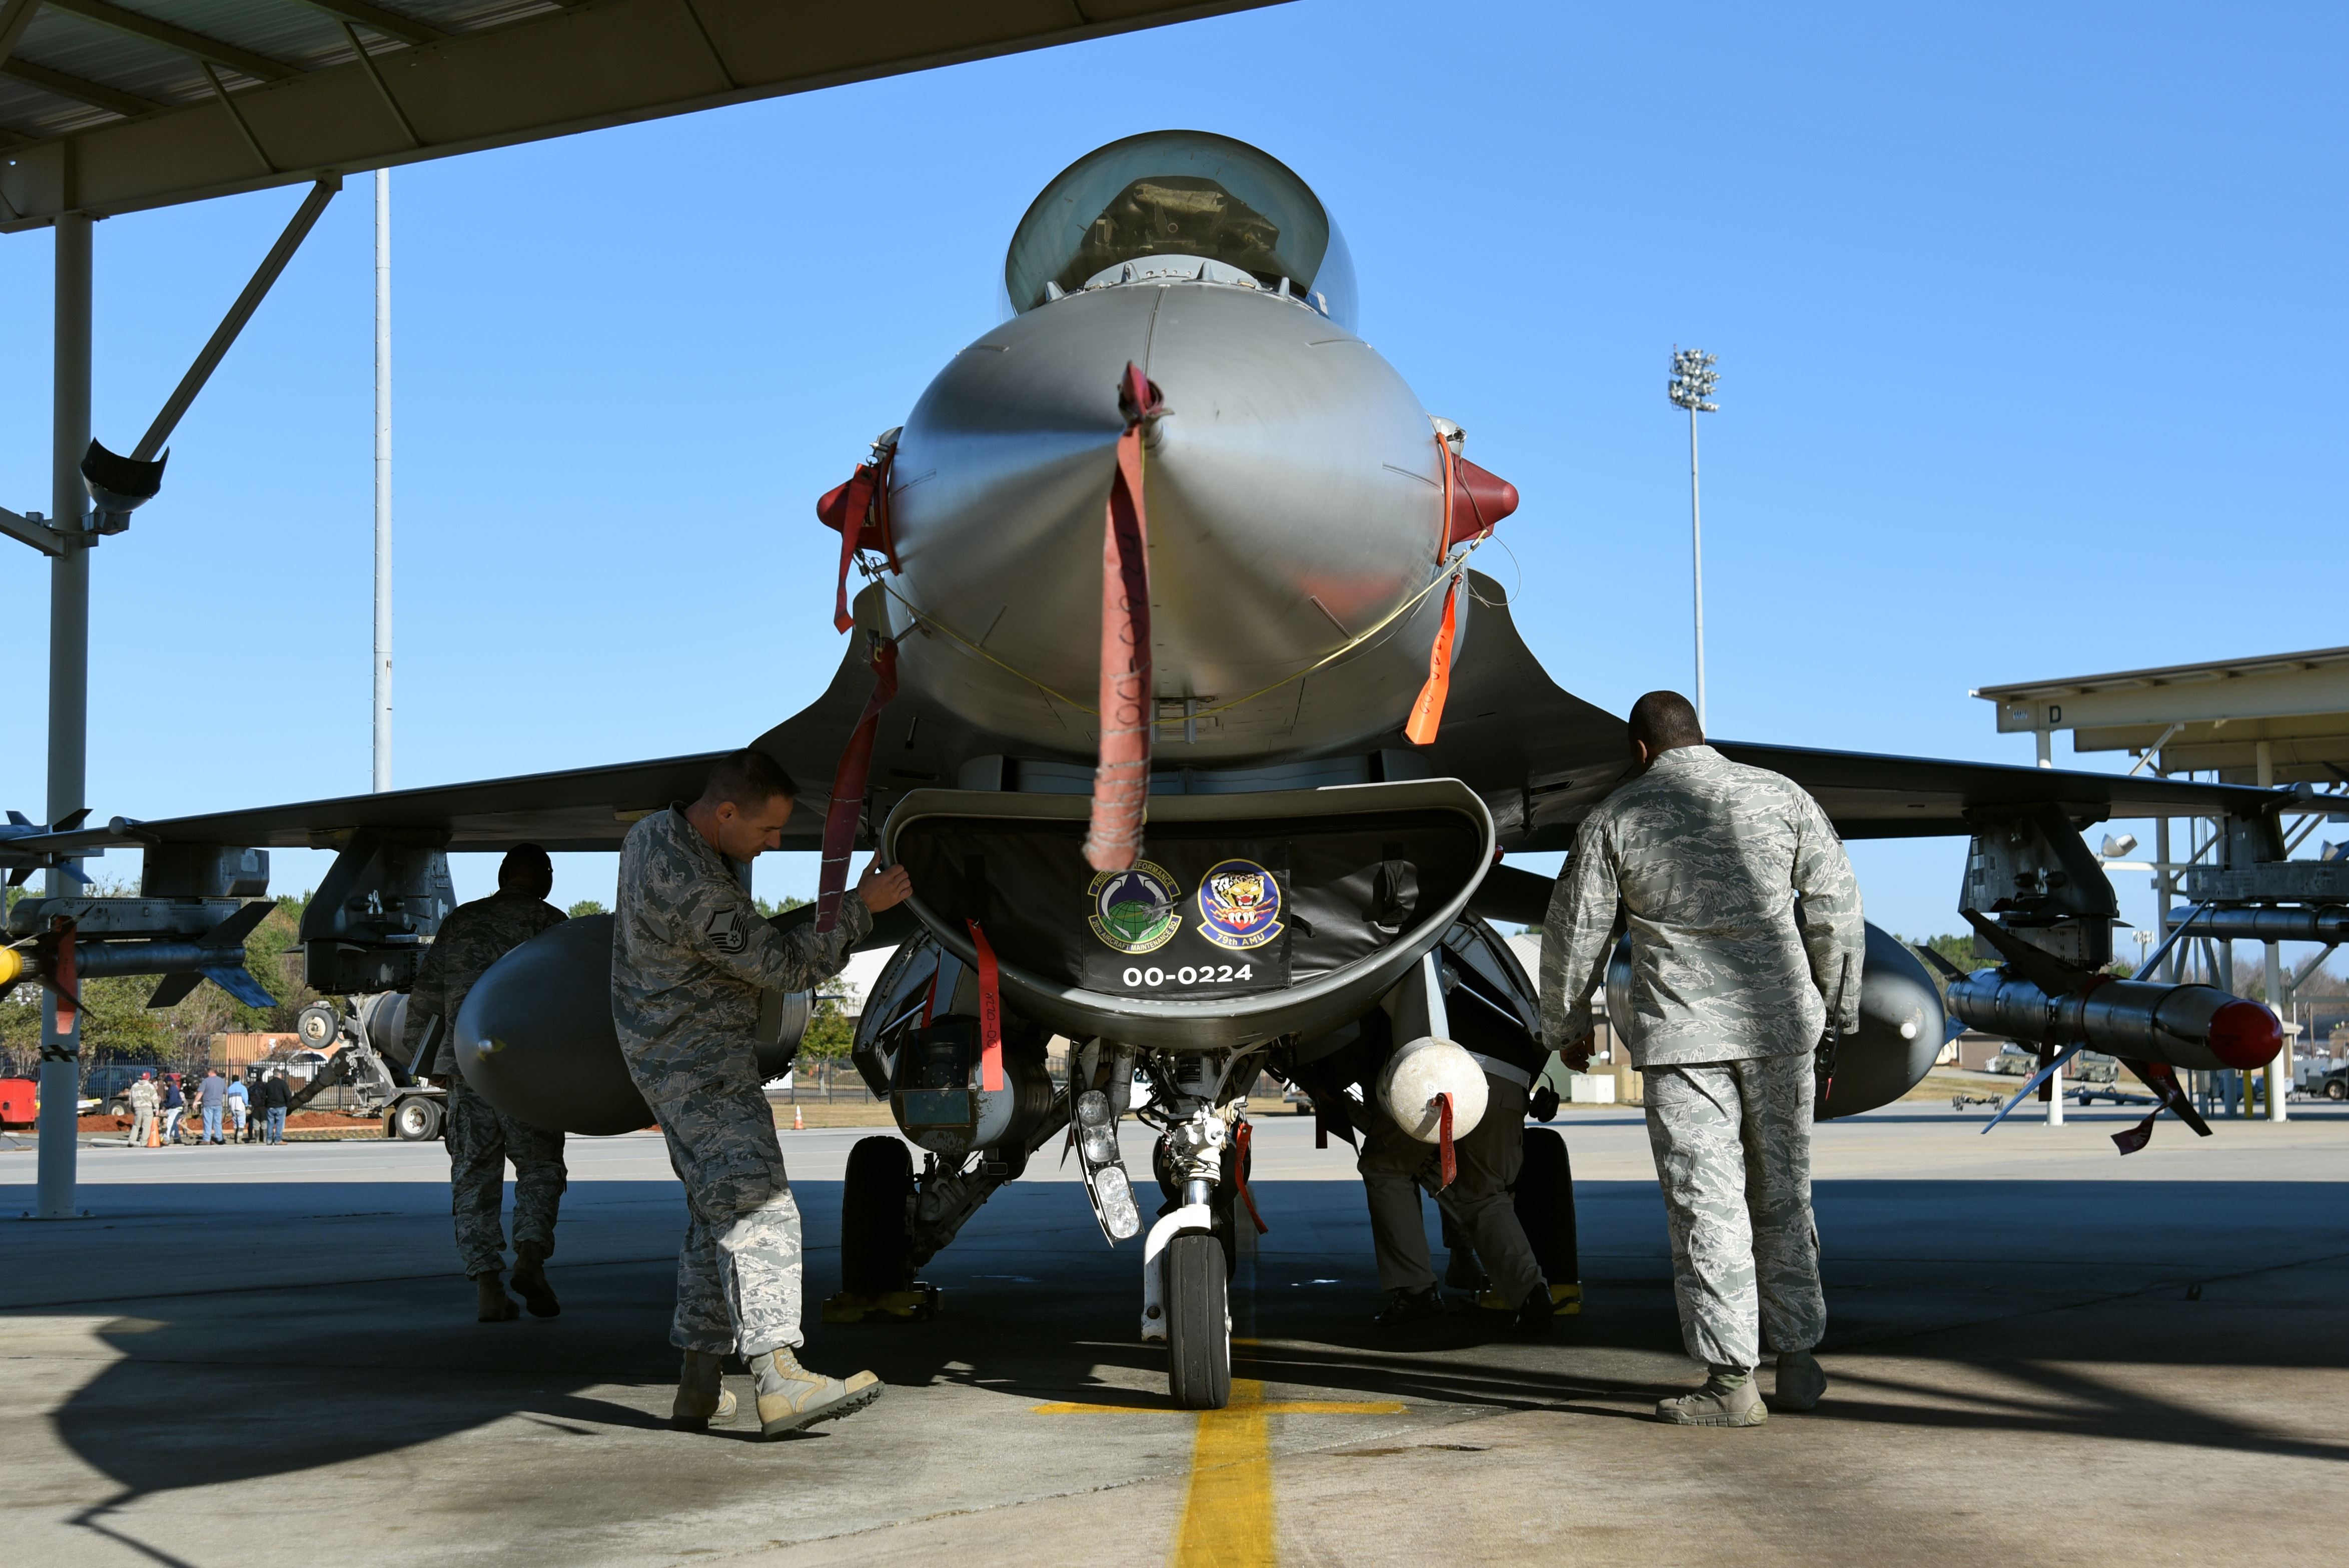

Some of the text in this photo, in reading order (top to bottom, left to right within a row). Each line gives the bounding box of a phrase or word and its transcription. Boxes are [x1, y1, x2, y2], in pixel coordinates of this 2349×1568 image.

[2049, 705, 2061, 723] D
[1094, 862, 1173, 887] PRIDE RFORMANCE
[1092, 920, 1178, 951] 20TH AIRCRAFT MAINTENANCE SQ.
[1216, 933, 1265, 945] 79th AMU
[1123, 964, 1253, 987] 00-0224
[986, 993, 997, 1048] 00-0224
